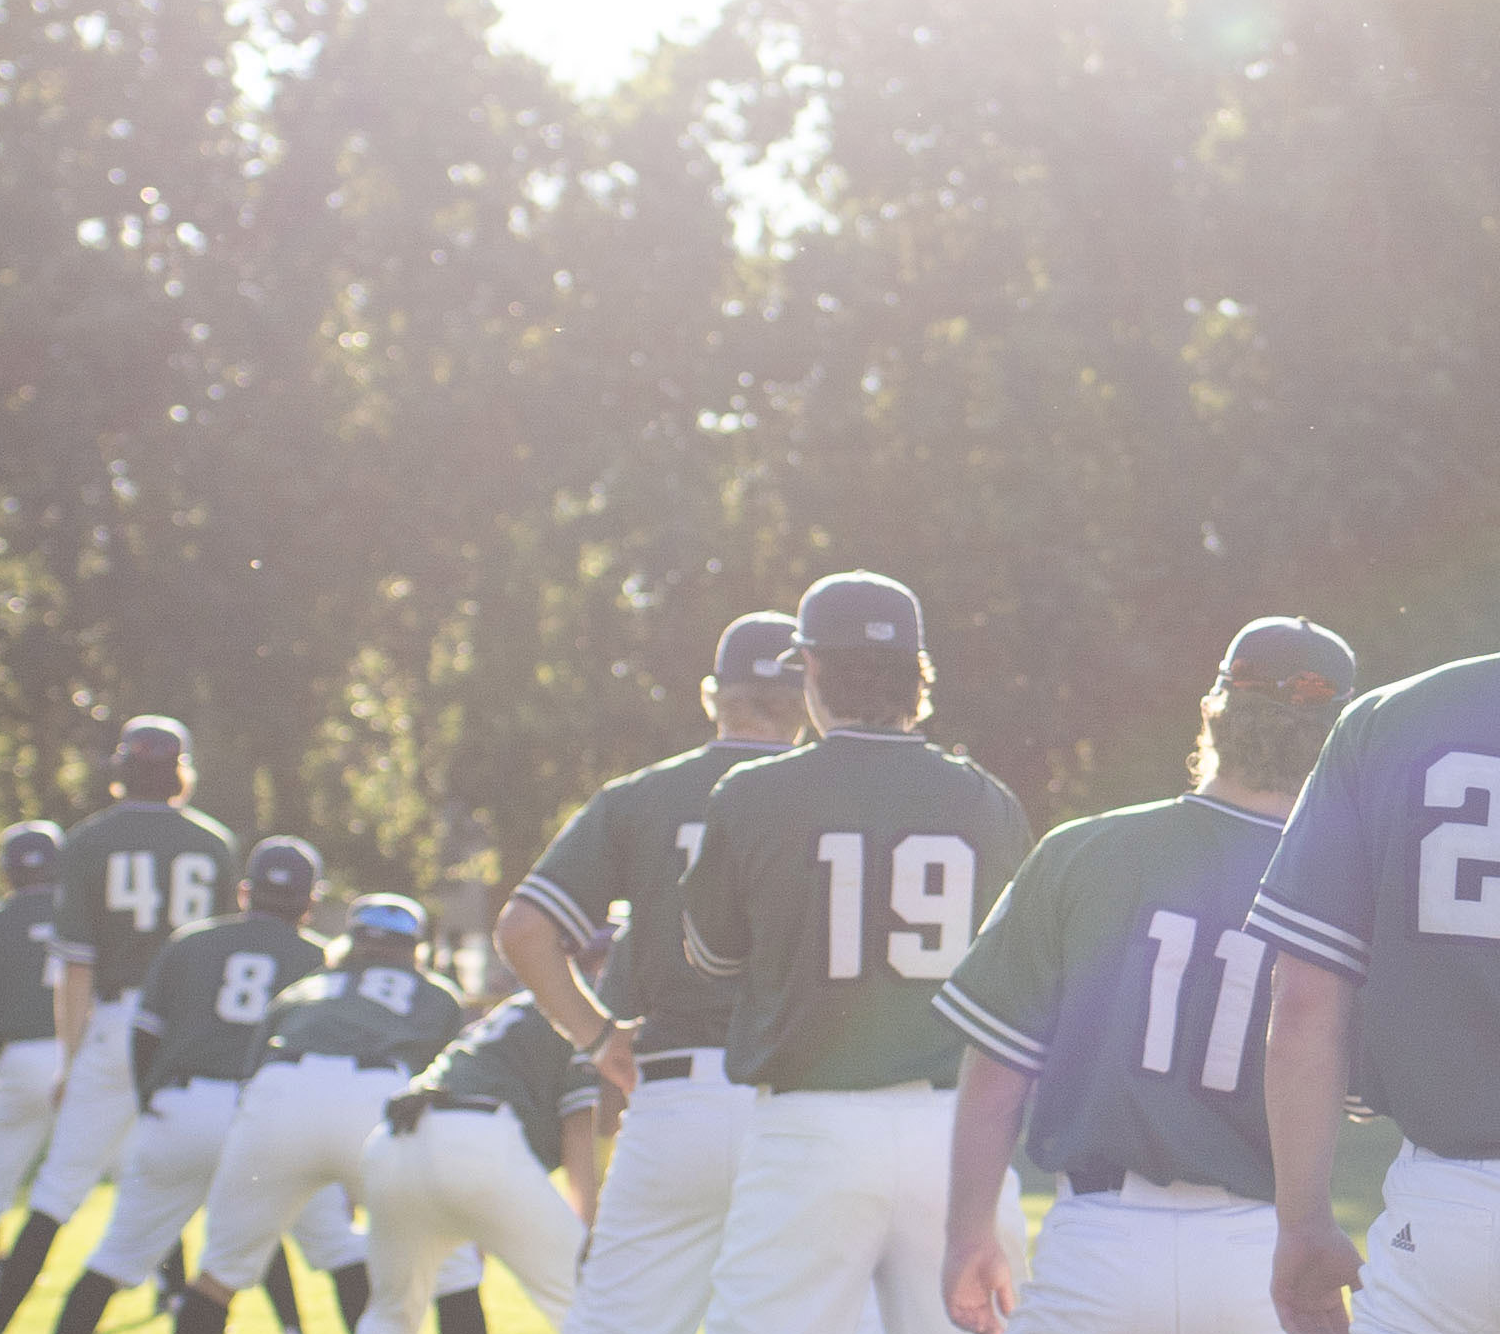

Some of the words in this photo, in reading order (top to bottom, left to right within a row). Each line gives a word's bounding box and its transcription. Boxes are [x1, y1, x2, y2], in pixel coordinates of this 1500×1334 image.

[105, 851, 219, 932] 46
[817, 832, 976, 979] 19
[214, 951, 278, 1025] 8
[1142, 910, 1267, 1092] 11
